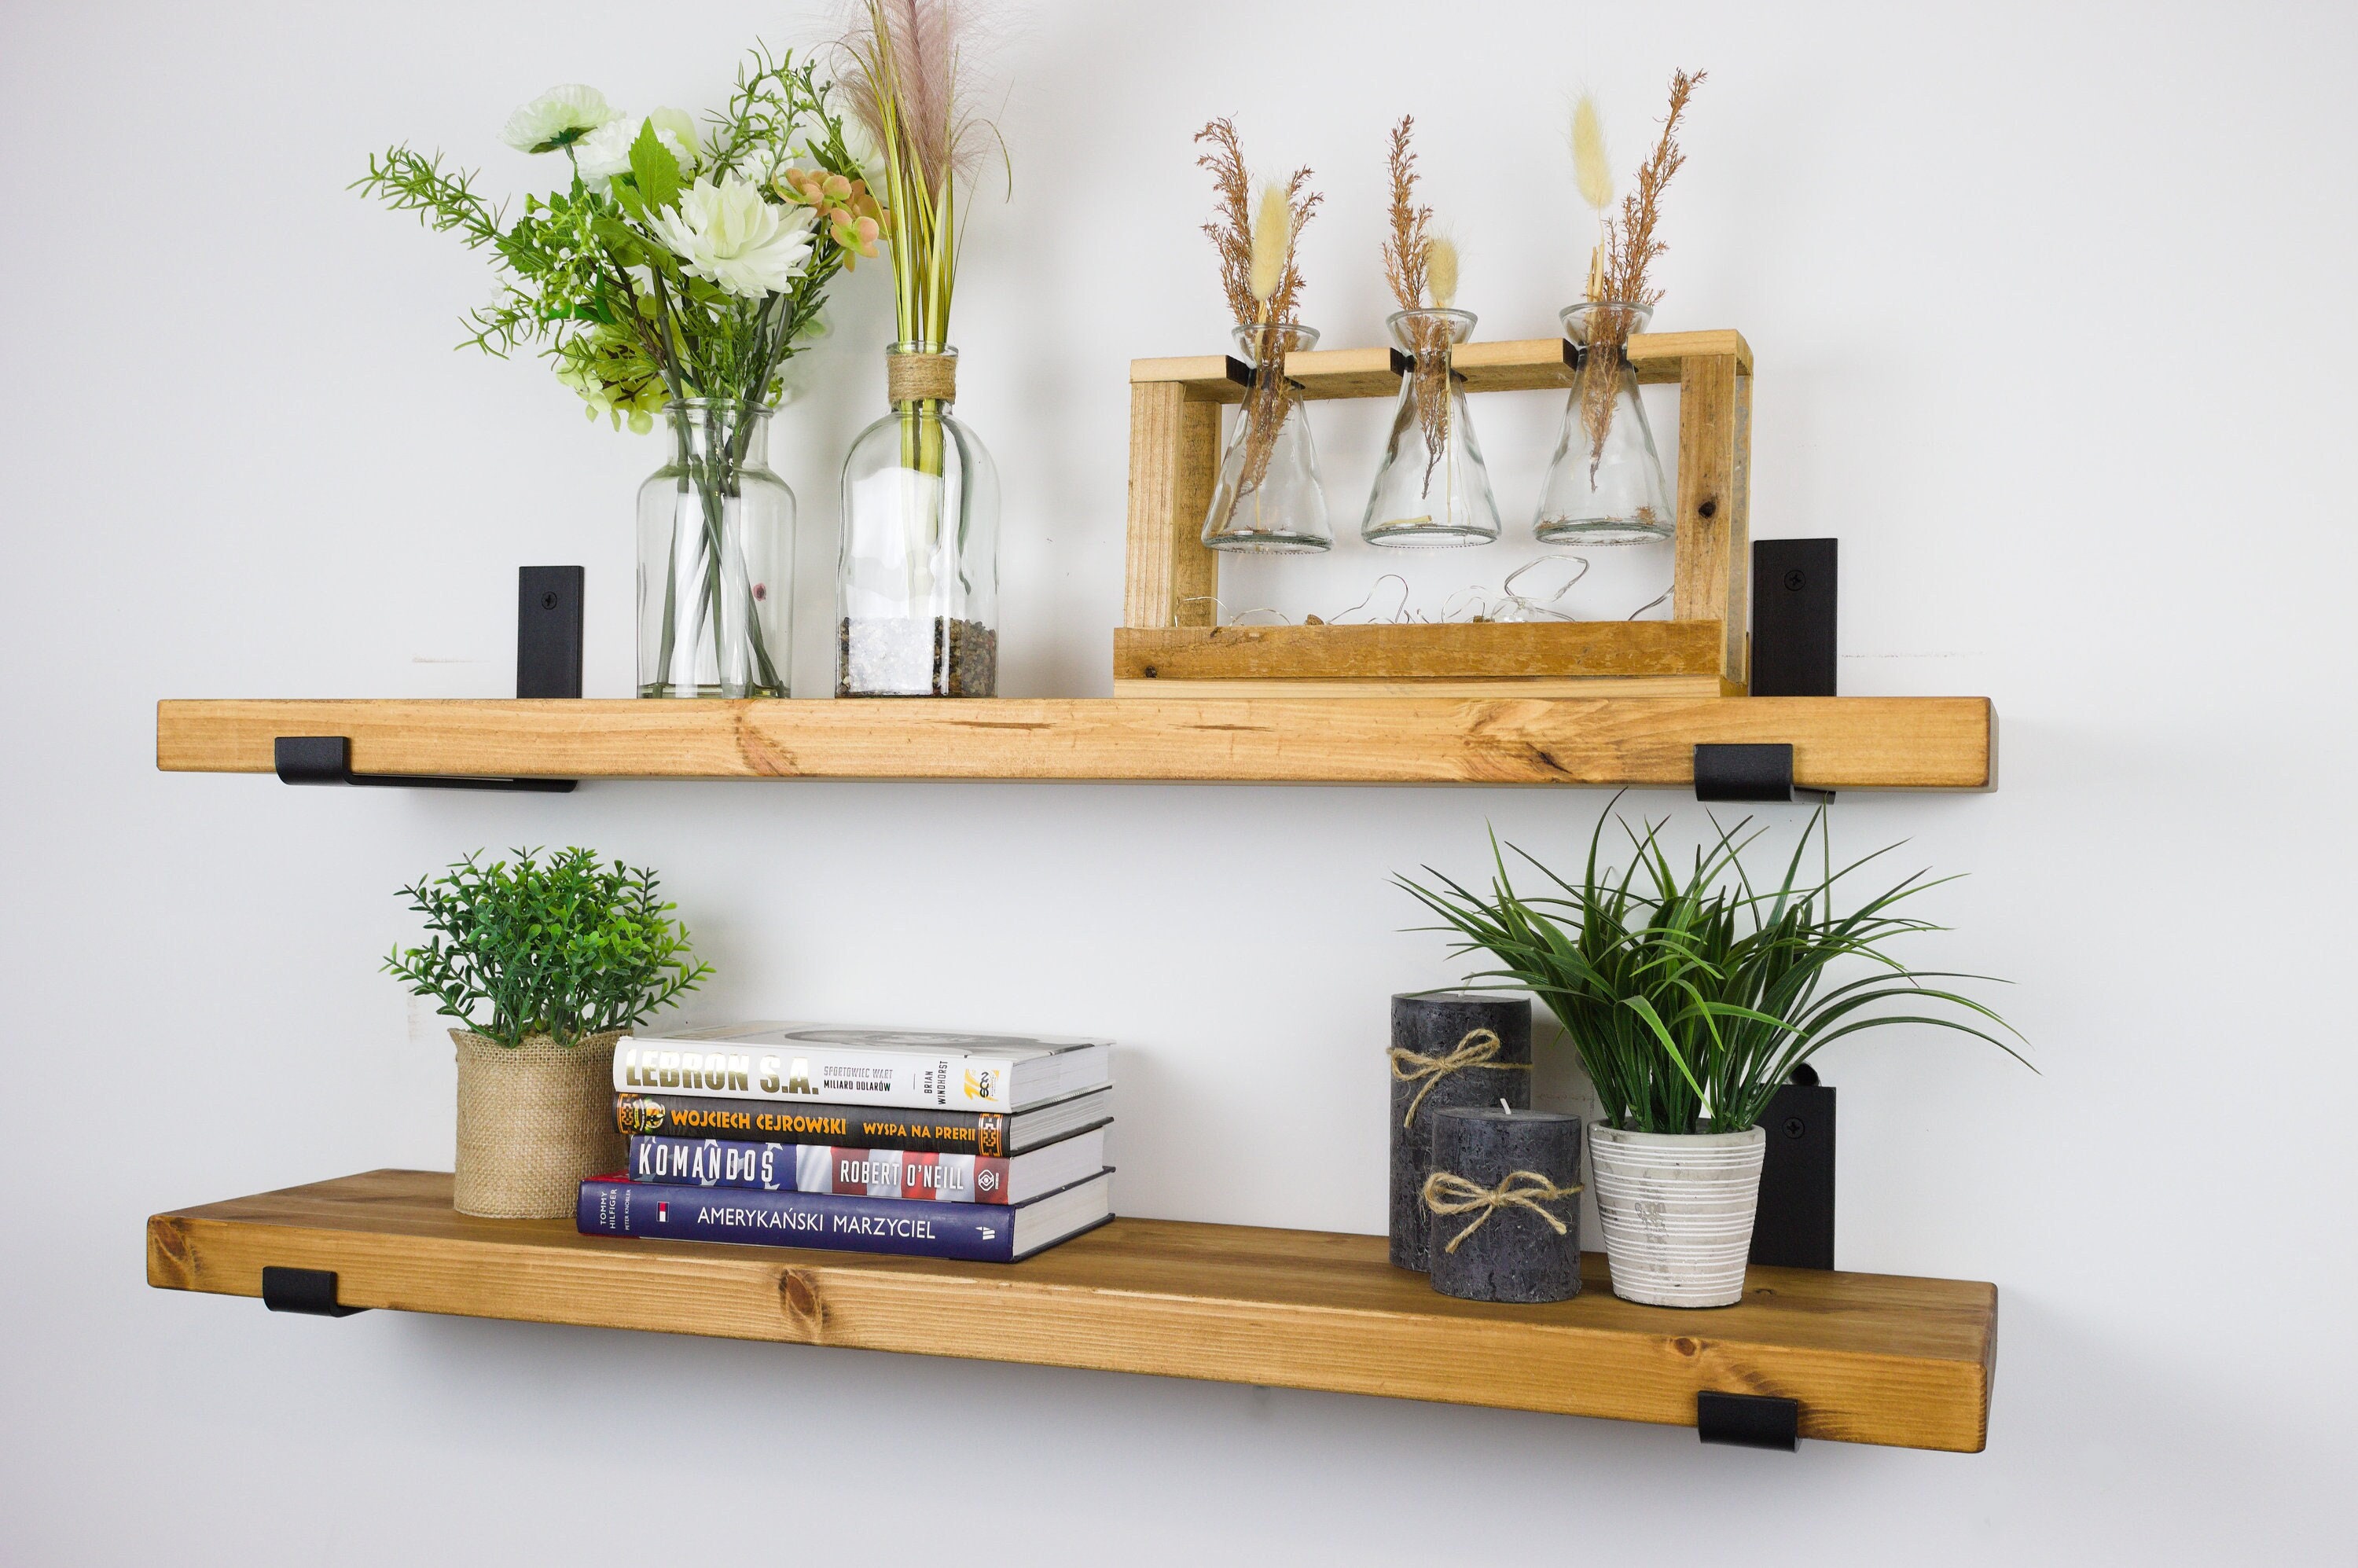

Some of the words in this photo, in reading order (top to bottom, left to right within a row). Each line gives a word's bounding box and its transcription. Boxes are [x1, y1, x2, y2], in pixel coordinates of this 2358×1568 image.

[626, 1048, 749, 1091] LEBRON
[759, 1055, 819, 1095] S.A.
[824, 1066, 870, 1078] SPORTOWIEC
[872, 1068, 893, 1079] WART
[824, 1079, 854, 1090] MILIARD
[856, 1080, 891, 1092] DOLARÓW
[924, 1070, 933, 1094] BRIAN
[938, 1061, 948, 1105] WINDHORST
[671, 1109, 751, 1129] WOJCIECH
[756, 1114, 847, 1135] CEJROWSKI
[863, 1122, 907, 1137] WYSPA
[911, 1125, 931, 1138] NA
[935, 1126, 975, 1141] PRERII
[638, 1143, 774, 1183] KOMANDOS
[840, 1159, 900, 1186] ROBERT
[907, 1164, 964, 1190] O'NEILL
[609, 1188, 618, 1229] HILFIGER
[697, 1206, 824, 1232] AMERYKAŃSKI
[833, 1215, 935, 1239] MARZYCIEL
